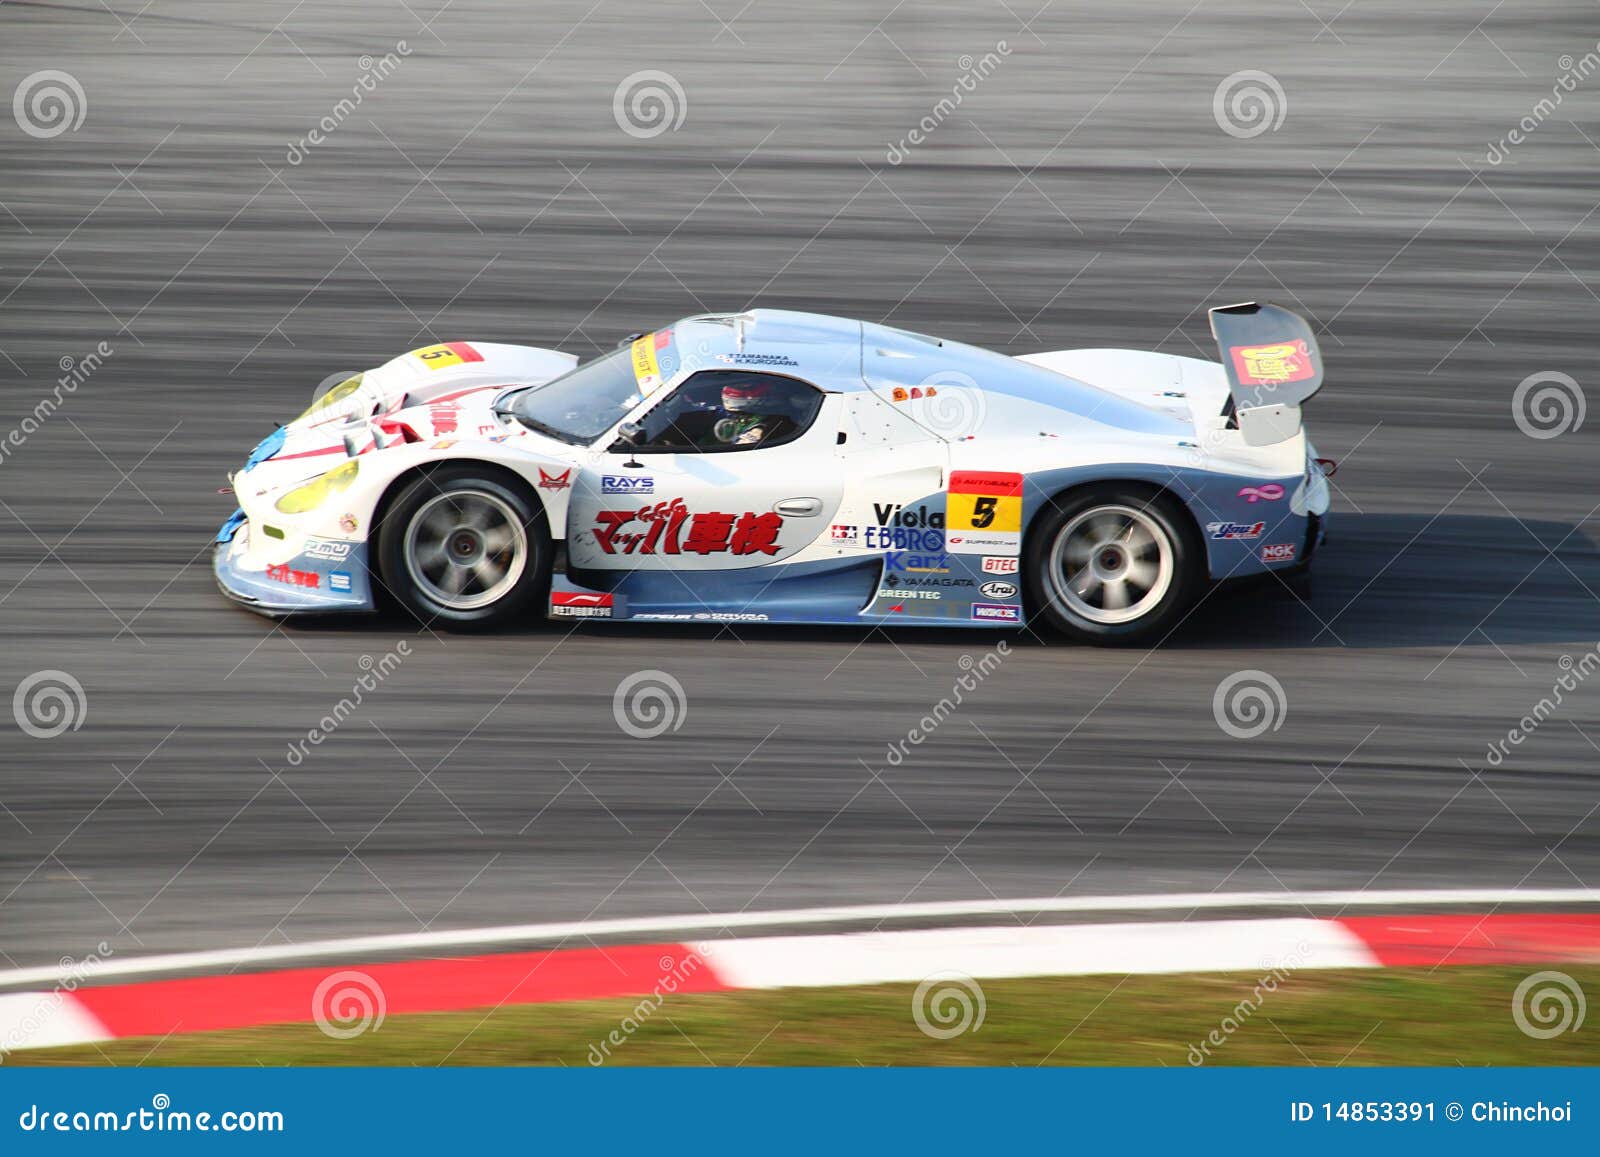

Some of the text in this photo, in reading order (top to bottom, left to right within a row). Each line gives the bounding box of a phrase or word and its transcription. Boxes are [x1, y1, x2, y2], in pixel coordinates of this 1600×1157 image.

[601, 476, 654, 487] RAYS
[873, 503, 945, 529] Viola
[971, 497, 998, 529] 5
[864, 527, 945, 552] EBBRO
[1263, 546, 1294, 558] NGK
[886, 552, 950, 570] Kart
[985, 559, 1017, 571] BTEC
[902, 578, 975, 587] YAMAGATA
[880, 589, 941, 600] GREEN TEC
[982, 584, 1013, 594] Arai
